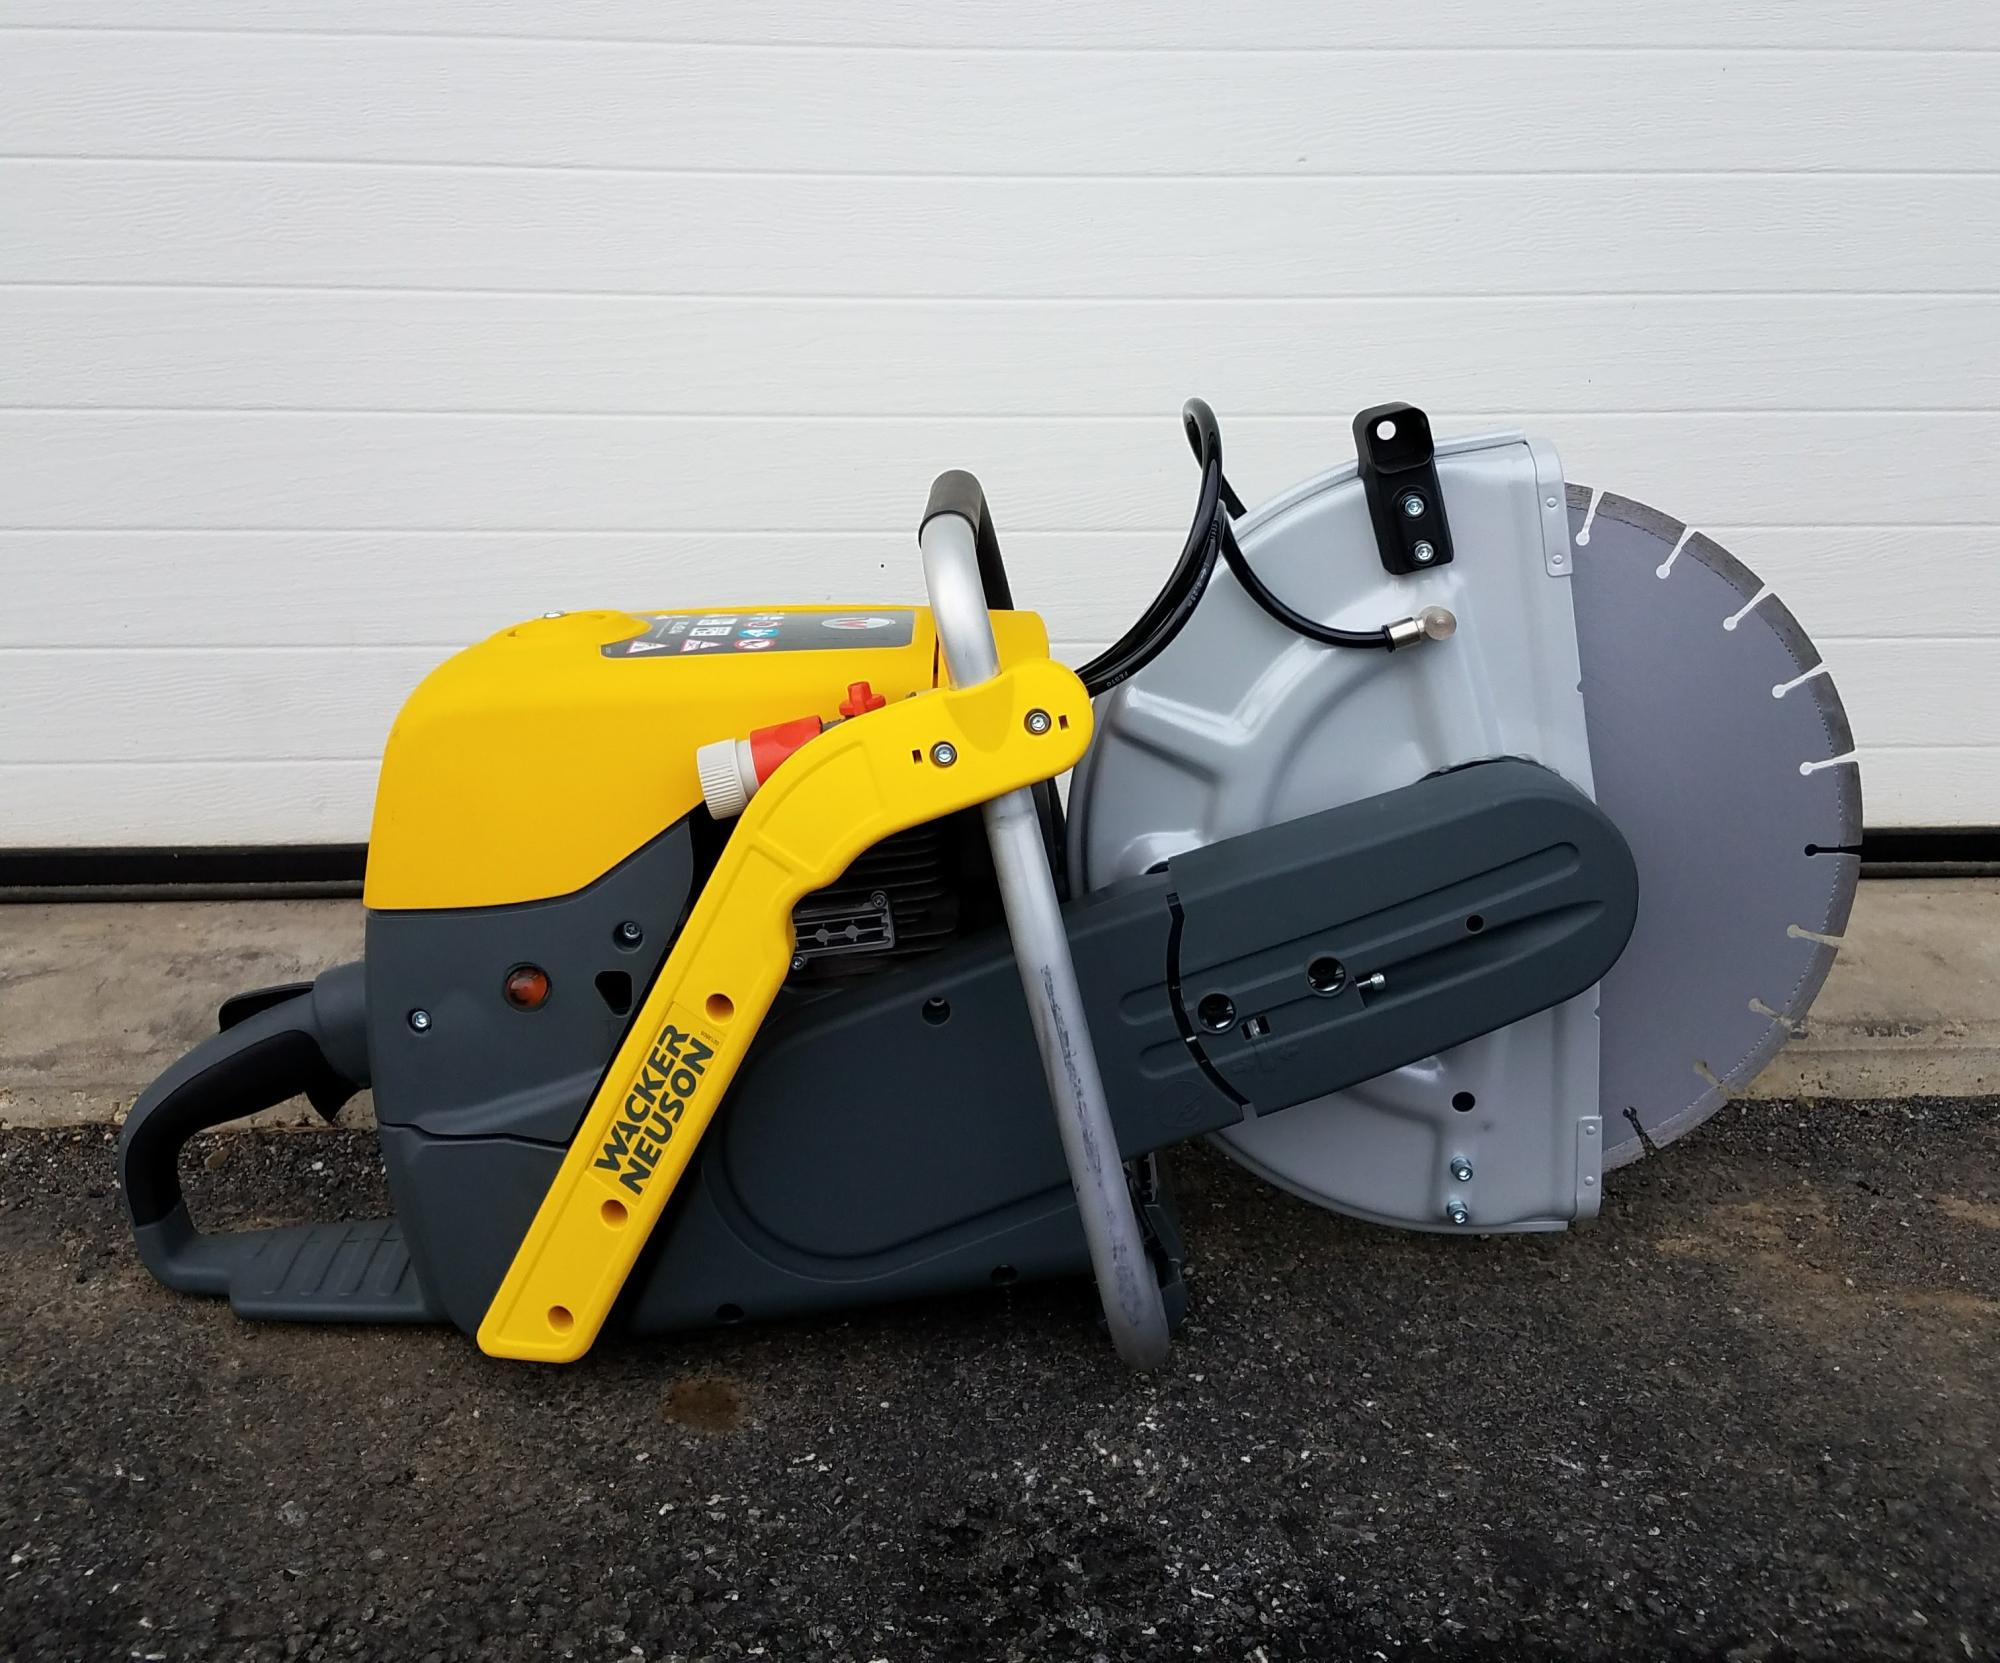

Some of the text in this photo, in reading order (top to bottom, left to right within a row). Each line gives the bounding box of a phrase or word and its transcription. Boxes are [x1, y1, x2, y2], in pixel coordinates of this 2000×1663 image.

[1106, 671, 1129, 687] FESTO
[595, 1025, 690, 1171] WACKER
[620, 1038, 714, 1195] NEUSON
